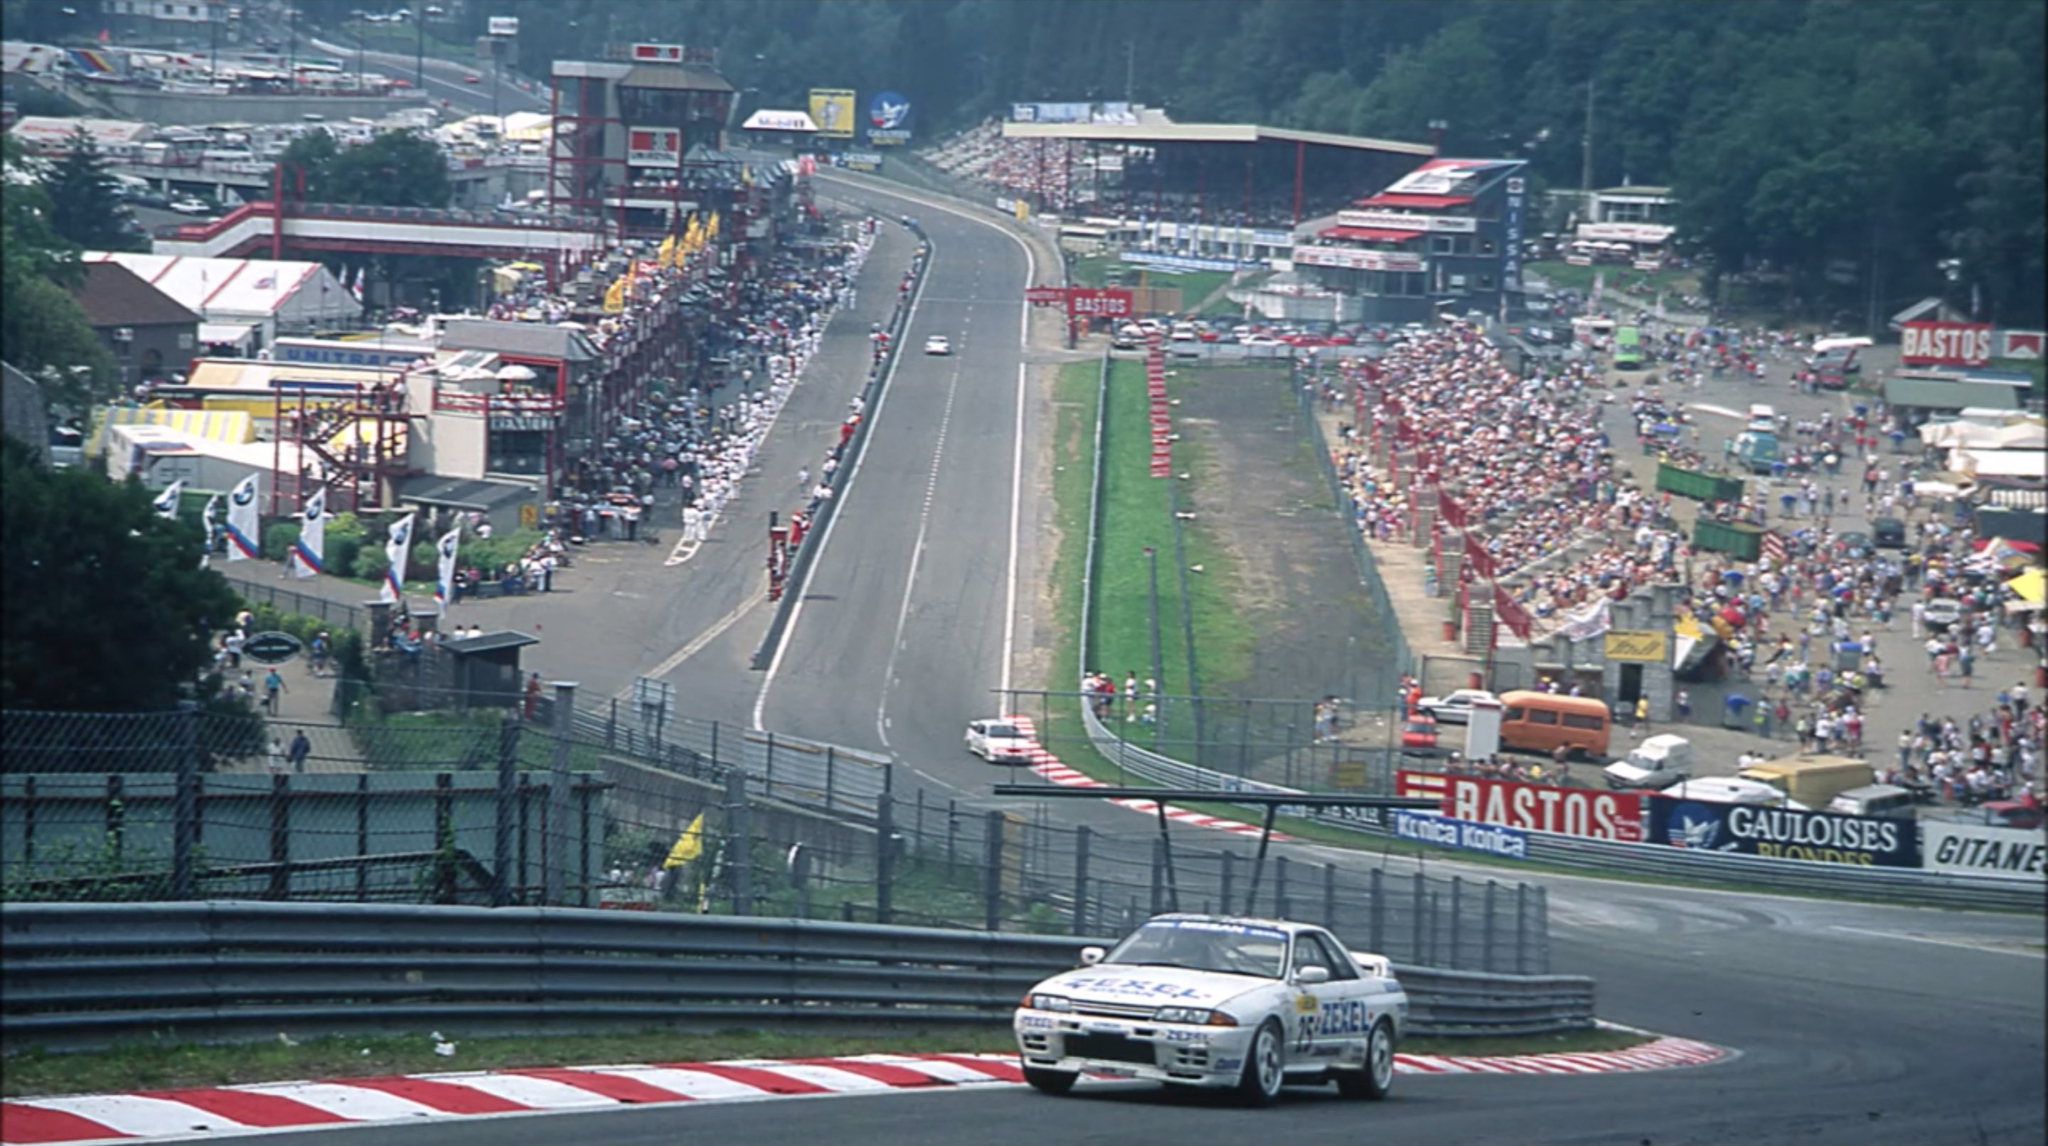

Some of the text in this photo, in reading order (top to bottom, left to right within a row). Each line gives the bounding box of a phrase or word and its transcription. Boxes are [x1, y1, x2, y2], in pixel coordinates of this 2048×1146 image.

[1074, 297, 1127, 313] BASTOS
[1902, 327, 1990, 360] BASTOS
[1455, 780, 1616, 841] BASTOS
[1397, 814, 1525, 857] Konica Konica
[1728, 806, 1898, 852] GAULOISES
[1757, 841, 1874, 866] BLONDES
[1935, 835, 2046, 873] GITANE
[1063, 978, 1200, 999] ZEXEL
[1320, 1001, 1370, 1034] ZEXEL
